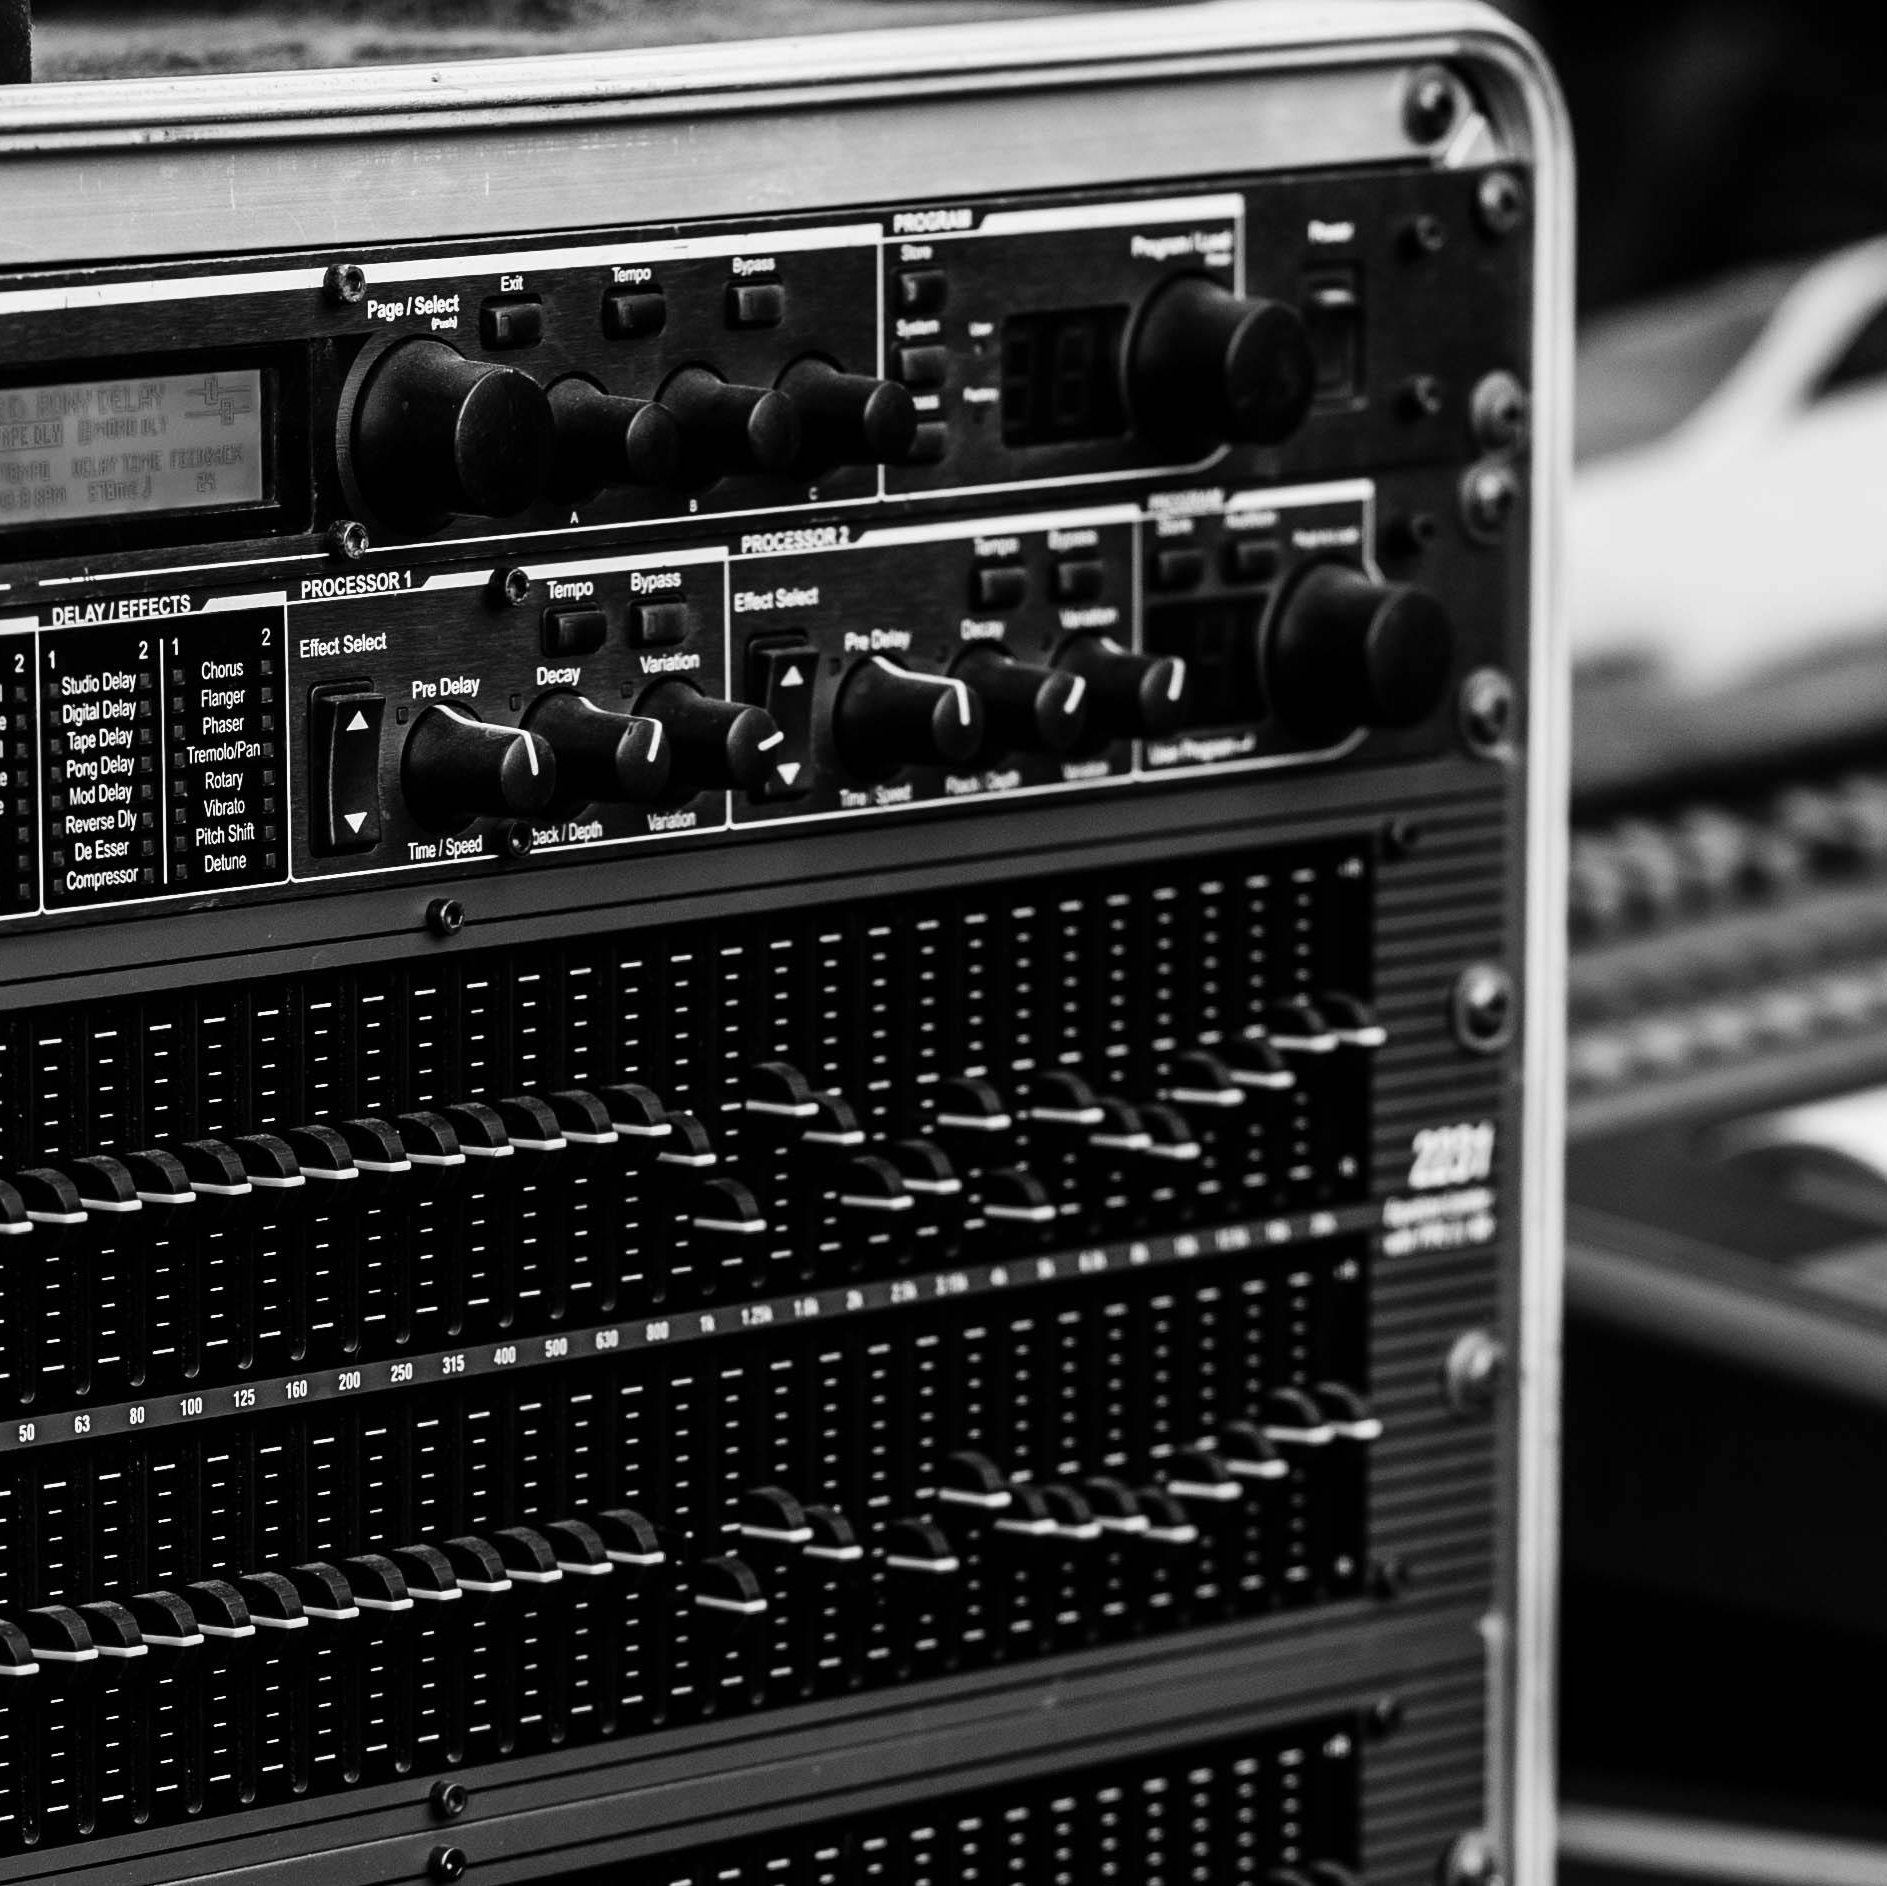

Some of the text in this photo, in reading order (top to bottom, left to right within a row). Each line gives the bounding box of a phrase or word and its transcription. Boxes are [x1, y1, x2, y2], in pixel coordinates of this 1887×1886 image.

[612, 267, 651, 284] Tempo
[733, 257, 775, 276] Bypass
[501, 275, 523, 291] Exit
[368, 300, 404, 321] Page
[415, 294, 459, 315] Select
[431, 316, 457, 330] (Push)
[570, 512, 578, 523] A
[741, 526, 850, 553] PROCESSOR 2
[300, 570, 412, 599] PROCESSOR 1
[547, 581, 593, 600] Tempo
[631, 572, 681, 594] Bypass
[52, 604, 105, 627] DELAY
[117, 594, 192, 623] EFFECTS
[734, 587, 819, 612] Effect Select
[300, 632, 387, 658] Effect Select
[202, 662, 243, 679] Chorus
[640, 653, 700, 673] Variation
[62, 671, 136, 695] Studio Delay
[412, 676, 480, 699] Pre Delay
[537, 667, 580, 686] Decay
[202, 689, 245, 709] Flanger
[63, 699, 136, 726] Digital Delay
[203, 717, 244, 735] Phaser
[67, 727, 133, 754] Tape Delay
[187, 741, 260, 764] Tremolo/Pan
[67, 755, 134, 780] Pong Delay
[206, 772, 243, 790] Rotary
[70, 783, 132, 805] Mod Delay
[204, 798, 245, 817] Vibrato
[66, 810, 137, 834] Reverse Dly
[648, 811, 696, 831] Variation
[196, 822, 254, 846] Pitch Shift
[75, 840, 129, 861] De Esser
[408, 842, 436, 860] Time
[446, 835, 482, 858] Speed
[205, 854, 246, 872] Detune
[67, 868, 138, 891] Compressor
[19, 1424, 34, 1442] 50
[75, 1415, 90, 1433] 63
[130, 1407, 144, 1424] 80
[180, 1397, 202, 1416] 100
[234, 1389, 255, 1407] 125
[286, 1380, 307, 1399] 160
[339, 1371, 360, 1390] 200
[391, 1363, 412, 1382] 250
[443, 1355, 464, 1374] 315
[494, 1346, 516, 1364] 400
[545, 1338, 567, 1357] 500
[596, 1330, 618, 1349] 630
